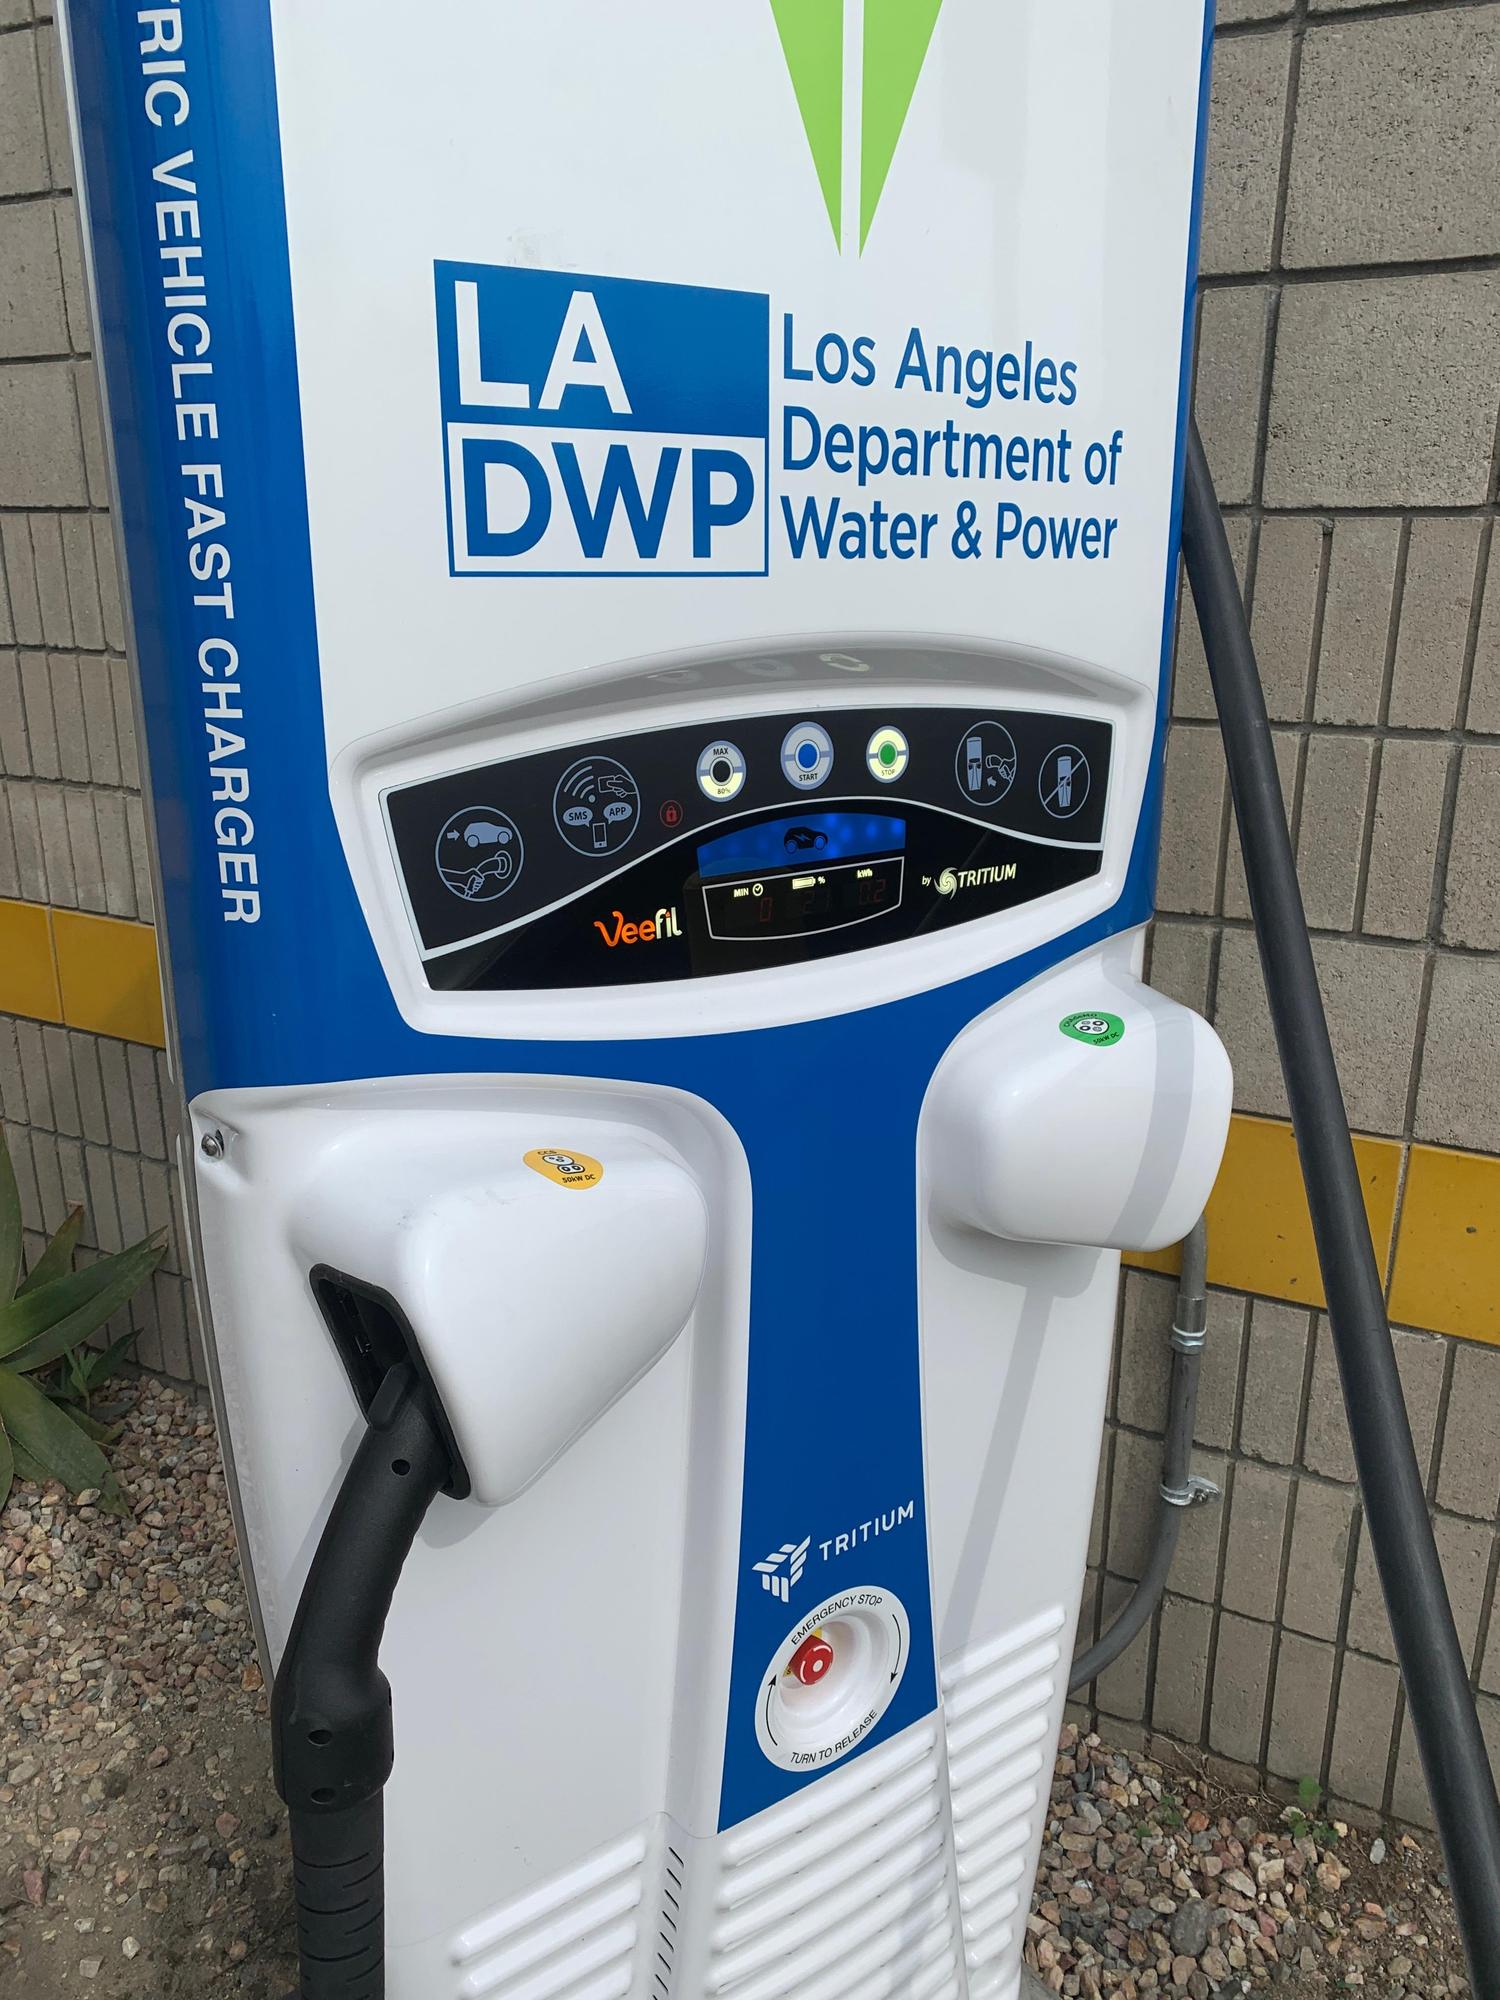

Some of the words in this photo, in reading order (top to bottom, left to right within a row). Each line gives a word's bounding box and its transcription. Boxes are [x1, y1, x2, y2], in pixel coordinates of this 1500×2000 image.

[137, 0, 190, 127] RIC
[152, 149, 219, 441] VEHICLE
[454, 280, 633, 414] LA
[783, 313, 876, 386] Los
[894, 327, 1078, 409] Angeles
[783, 405, 1072, 487] Department
[1084, 430, 1123, 485] of
[462, 438, 755, 559] DWP
[780, 495, 938, 559] Water
[951, 500, 982, 560] &
[996, 502, 1118, 559] Power
[181, 464, 235, 620] FAST
[198, 638, 261, 923] CHARGER
[713, 747, 729, 756] MAX
[799, 773, 818, 781] START
[569, 811, 588, 821] SMS
[609, 806, 626, 816] APP
[733, 888, 749, 898] MIN
[857, 868, 873, 879] kWh
[922, 875, 931, 886] by
[958, 863, 1017, 888] TRITIUM
[593, 906, 683, 947] Veefil
[819, 1500, 914, 1561] TRITIUM
[791, 1595, 856, 1645] EMERGENCY
[858, 1594, 882, 1606] STOP
[790, 1752, 816, 1764] TURN
[819, 1747, 832, 1760] TO
[835, 1709, 877, 1753] RELEASE
